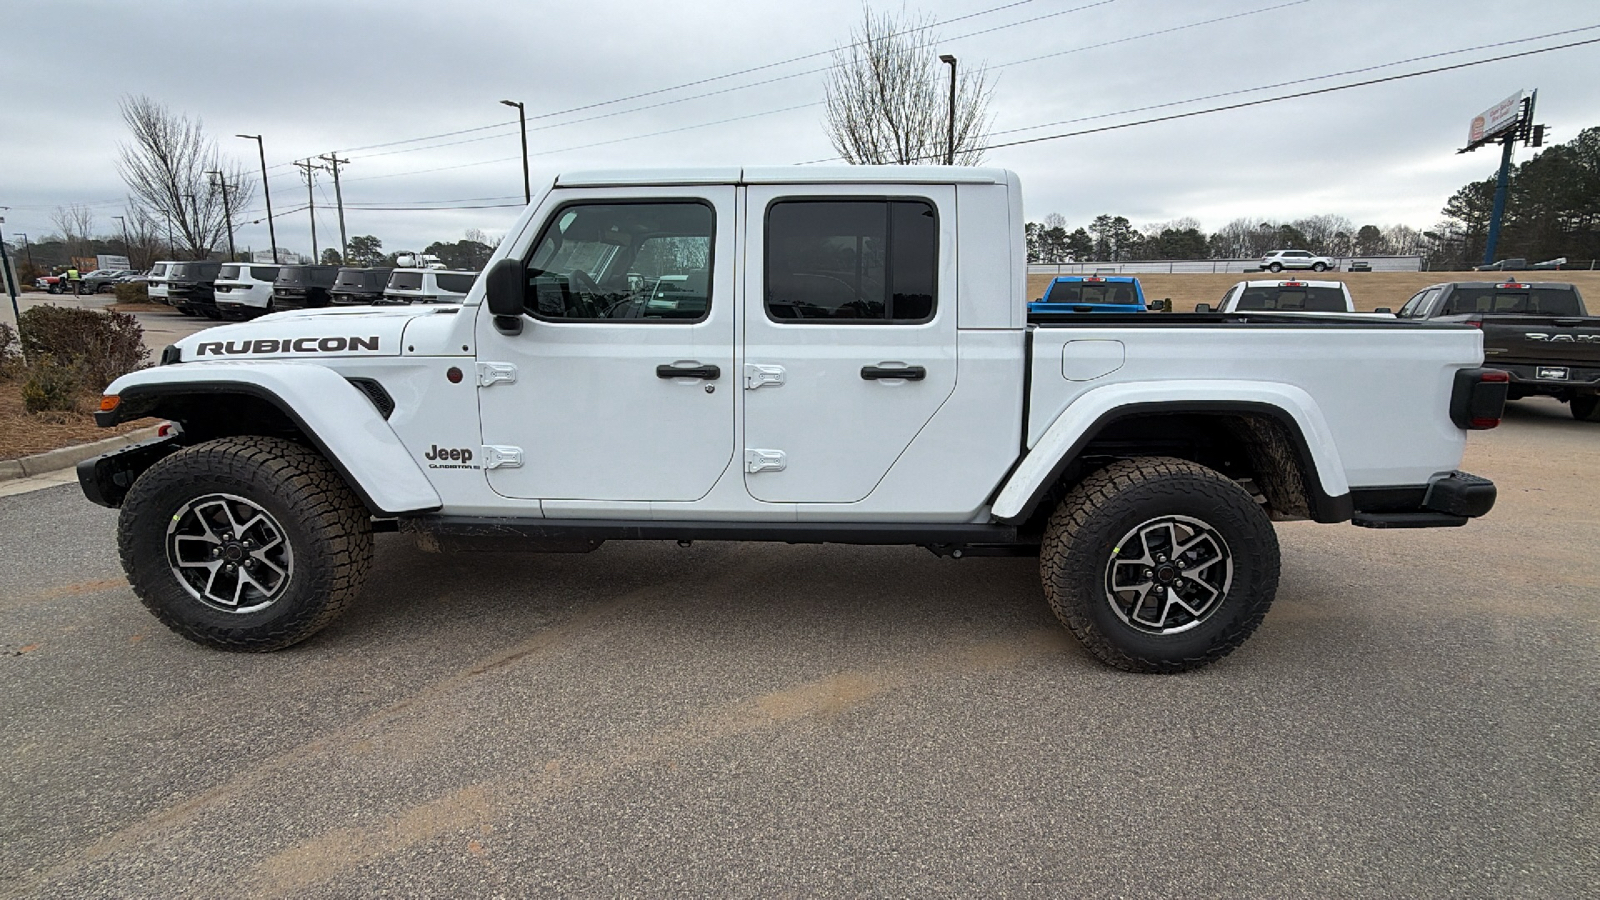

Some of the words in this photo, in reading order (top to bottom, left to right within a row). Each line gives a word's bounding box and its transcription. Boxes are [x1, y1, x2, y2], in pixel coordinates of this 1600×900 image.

[196, 336, 379, 356] RUBICON
[1525, 332, 1600, 343] RAM
[425, 444, 473, 464] Jeep
